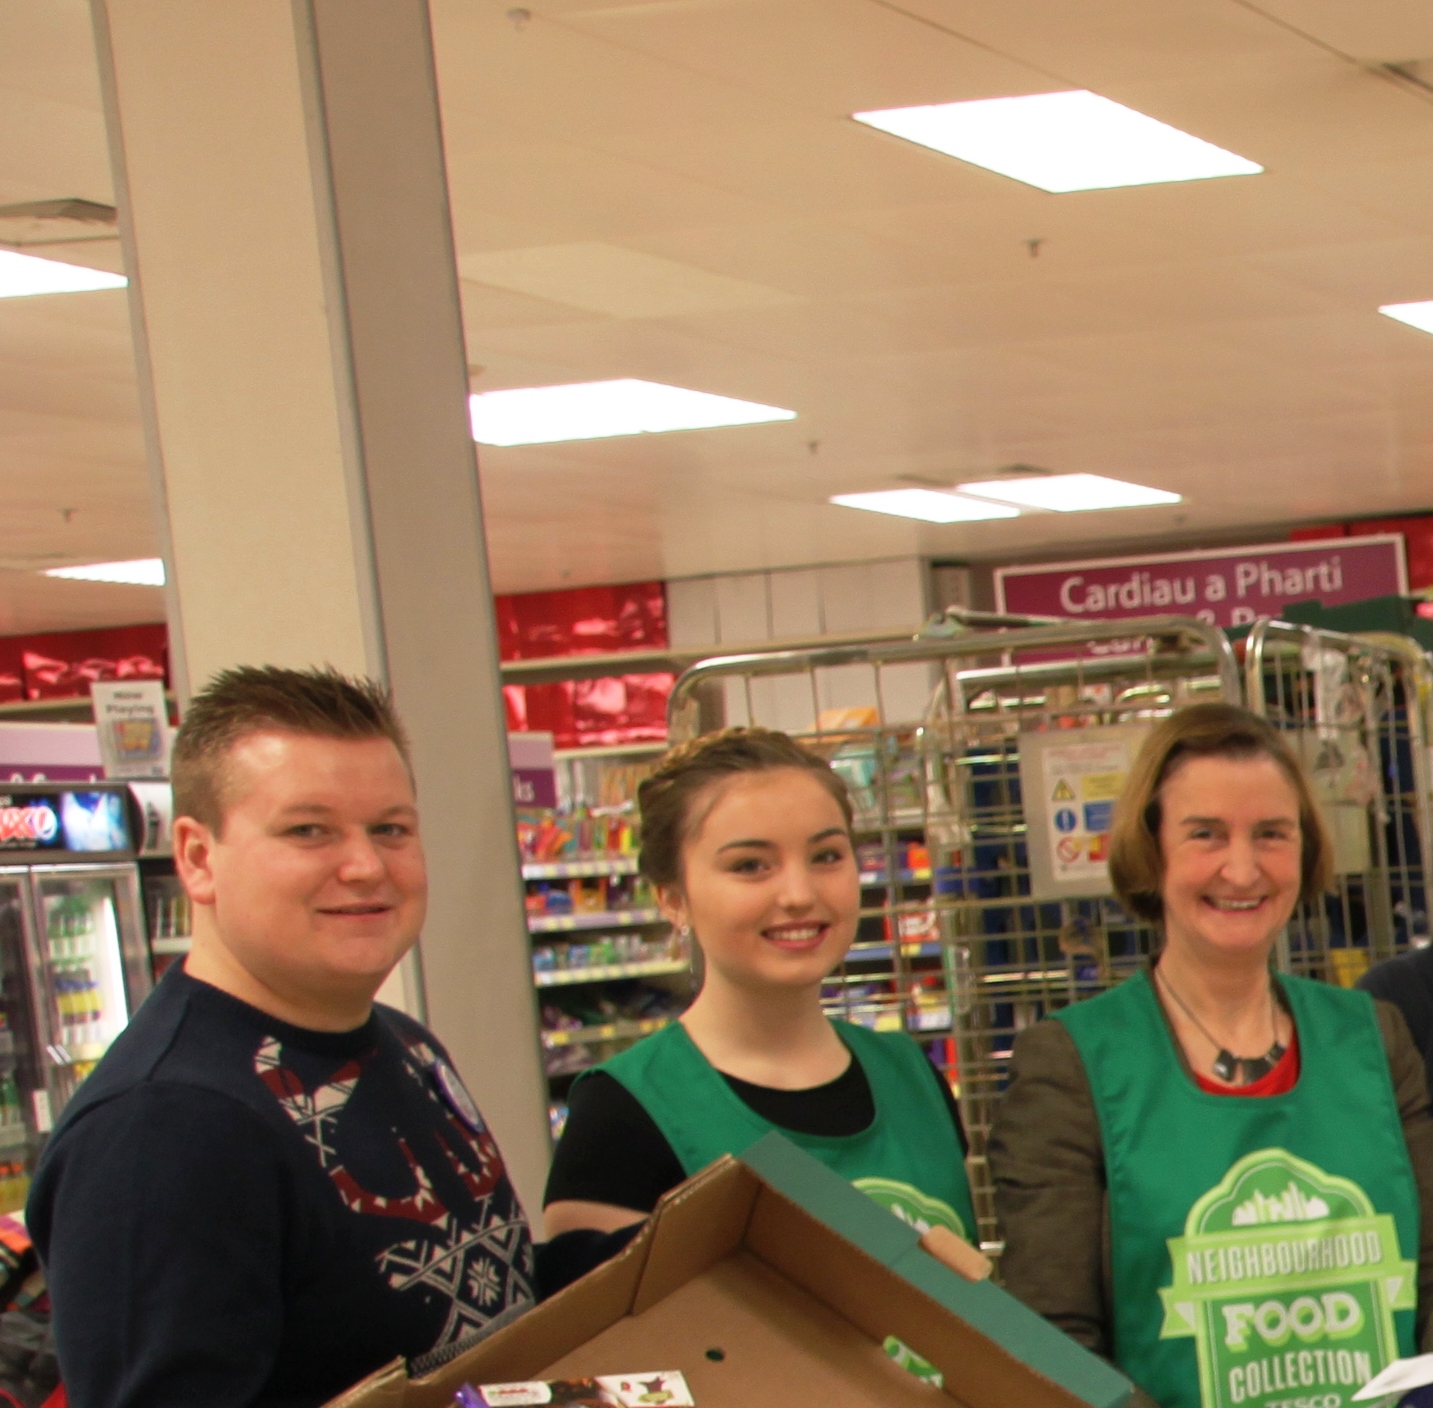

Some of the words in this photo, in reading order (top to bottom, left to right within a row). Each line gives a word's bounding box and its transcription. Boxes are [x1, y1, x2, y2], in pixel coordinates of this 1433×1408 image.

[1060, 572, 1195, 615] Cardiau
[1205, 574, 1228, 601] a
[1235, 555, 1344, 598] Pharti
[1186, 1231, 1384, 1284] NEIGHBOURHOOD
[1221, 1292, 1361, 1346] FOOD
[1229, 1349, 1371, 1402] COLLECTION
